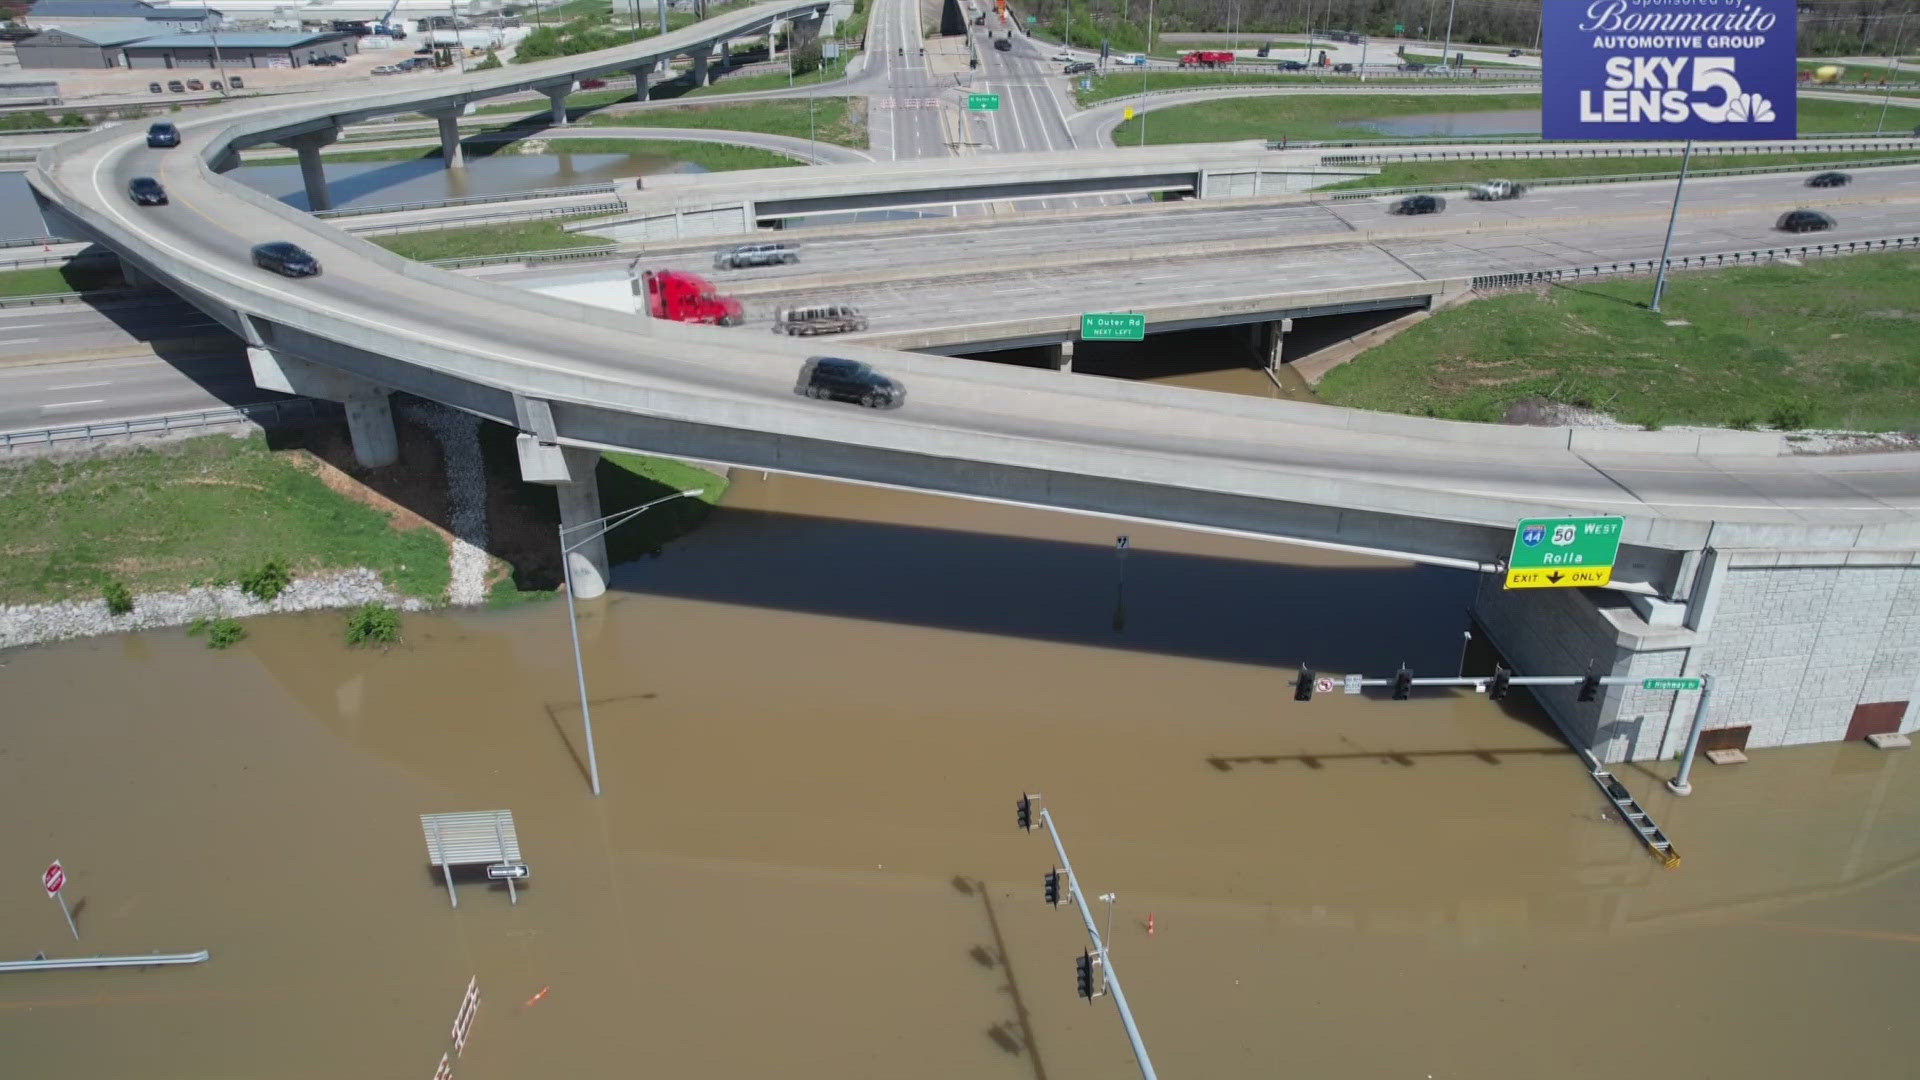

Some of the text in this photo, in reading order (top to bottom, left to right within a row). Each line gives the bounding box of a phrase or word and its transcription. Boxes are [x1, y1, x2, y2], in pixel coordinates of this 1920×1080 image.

[1086, 318, 1141, 326] N Outer Rd
[1524, 522, 1618, 542] 44 50 WEST
[1543, 552, 1583, 565] Rolla
[1512, 573, 1603, 583] EXIT ONLY
[1654, 680, 1686, 690] Highway
